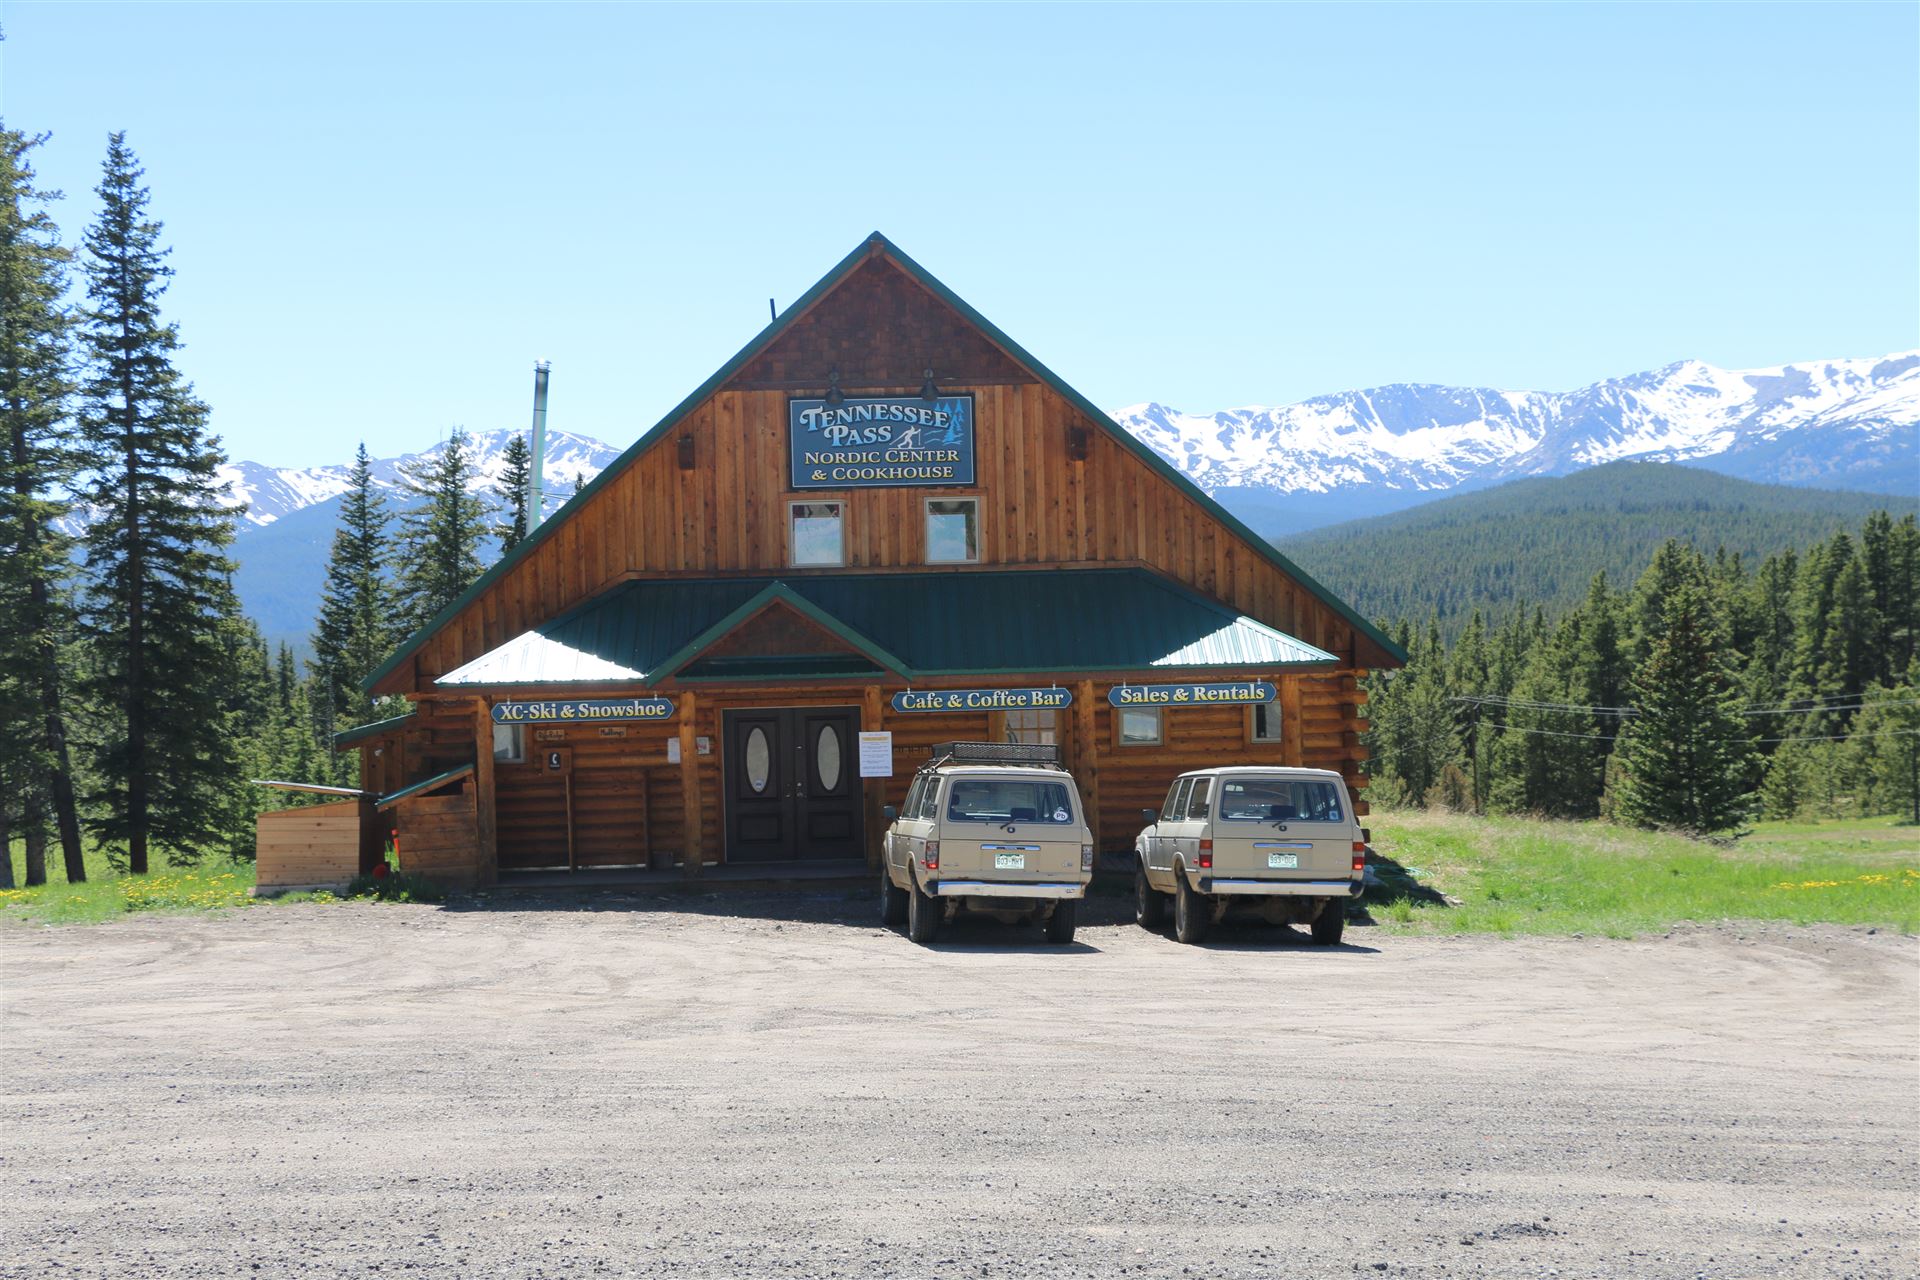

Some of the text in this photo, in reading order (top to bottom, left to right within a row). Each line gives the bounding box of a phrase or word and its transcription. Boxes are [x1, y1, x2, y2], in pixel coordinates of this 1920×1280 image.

[799, 403, 950, 432] TENNESSEE
[823, 425, 892, 447] PASS
[804, 449, 960, 465] NORDIC CENTER
[811, 466, 954, 481] & COOKHOUSE
[902, 690, 1064, 709] Cafe & Coffee Bar
[1120, 683, 1266, 703] Sales & Rentals
[501, 701, 666, 720] XC-Ski & Snowshoe
